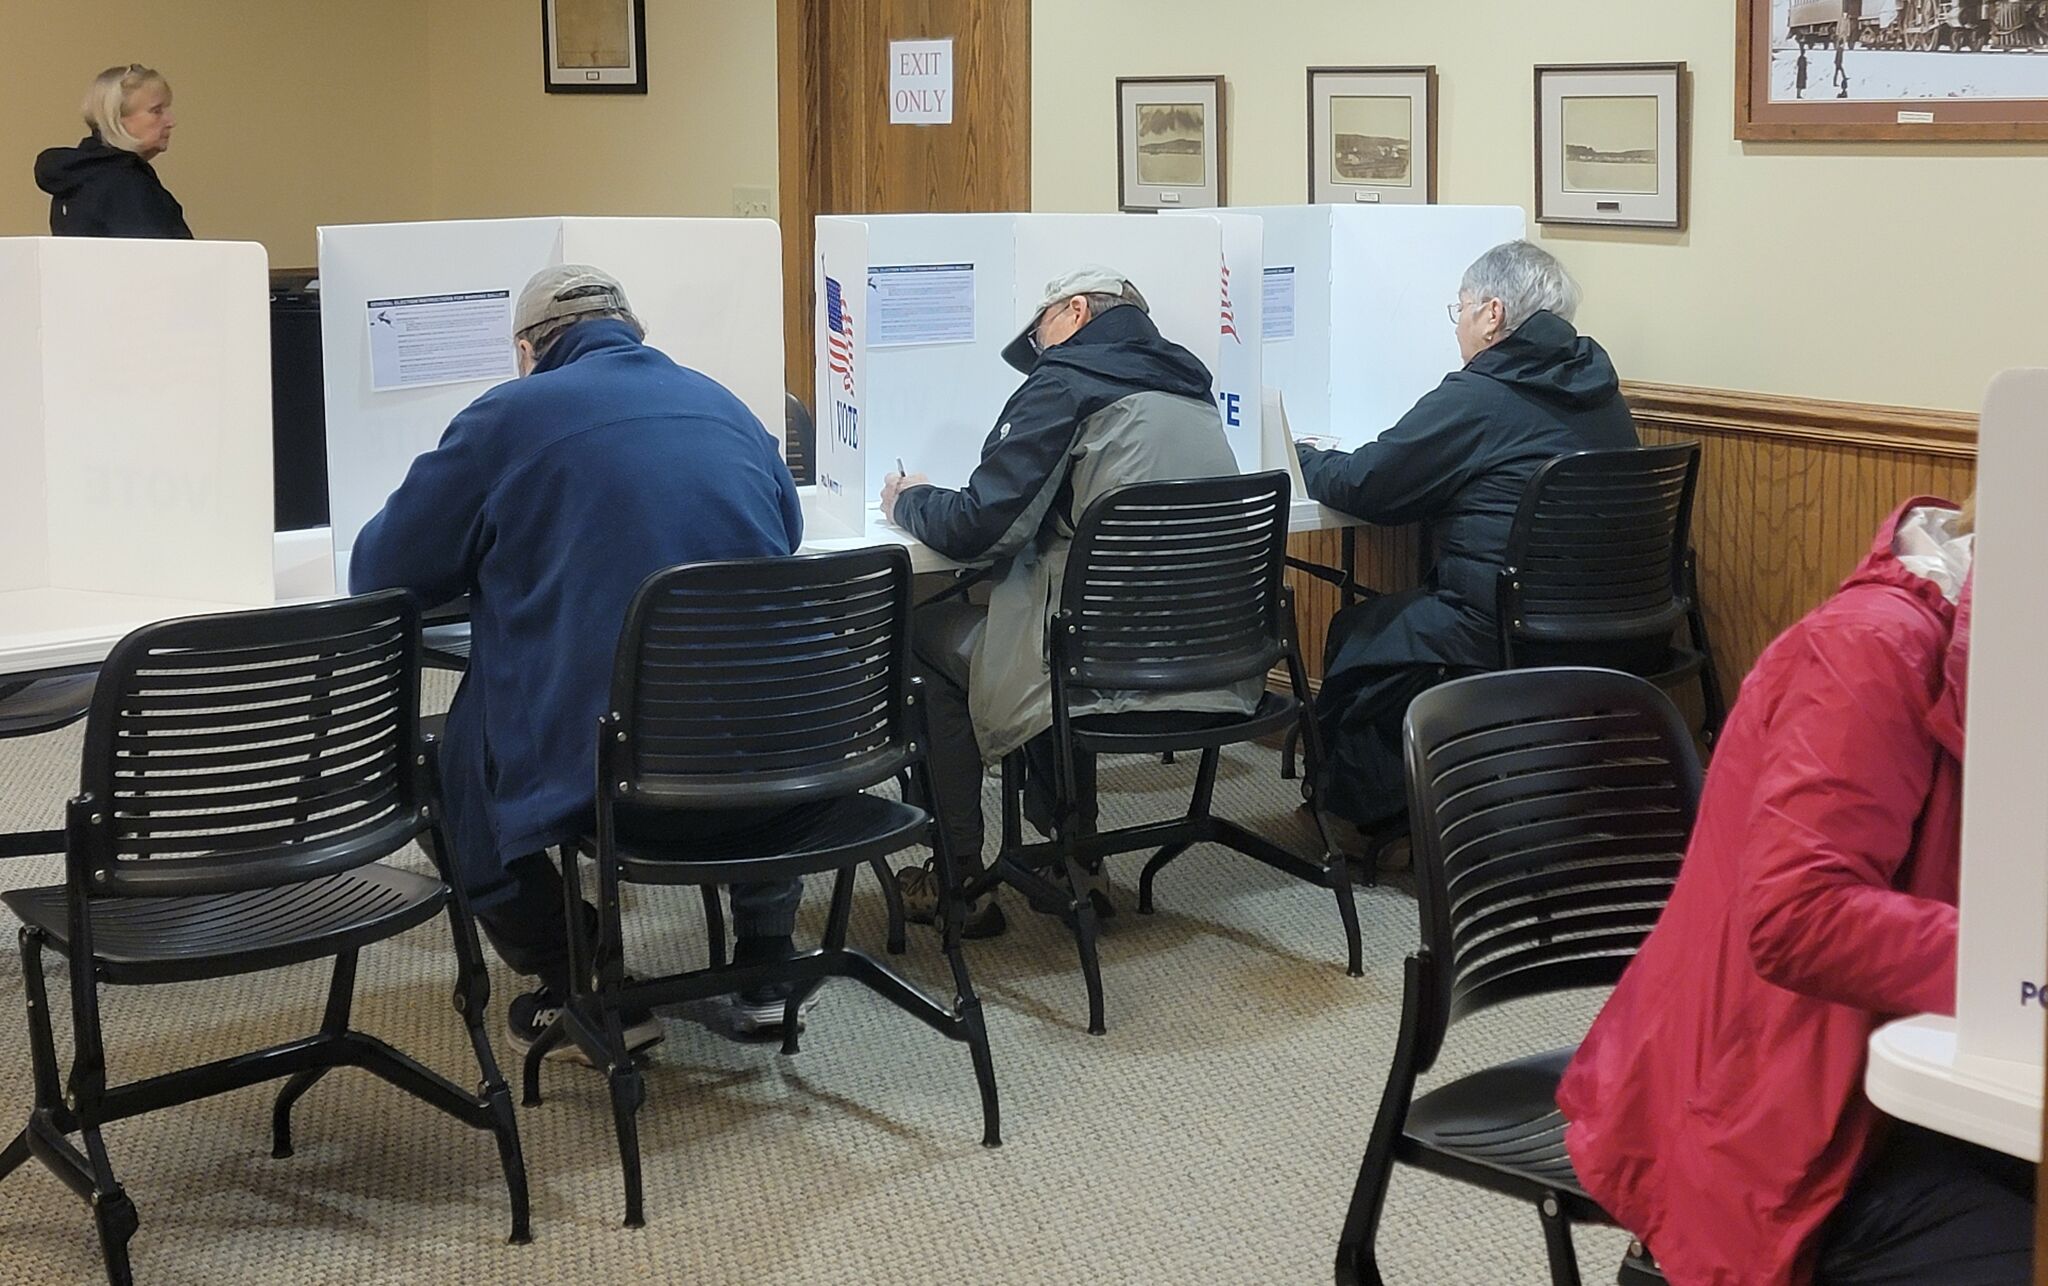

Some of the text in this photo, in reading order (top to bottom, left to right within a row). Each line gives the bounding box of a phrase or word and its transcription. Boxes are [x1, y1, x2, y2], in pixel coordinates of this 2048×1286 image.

[900, 52, 942, 76] EXIT
[895, 89, 945, 113] ONLY
[836, 400, 858, 450] VOTE
